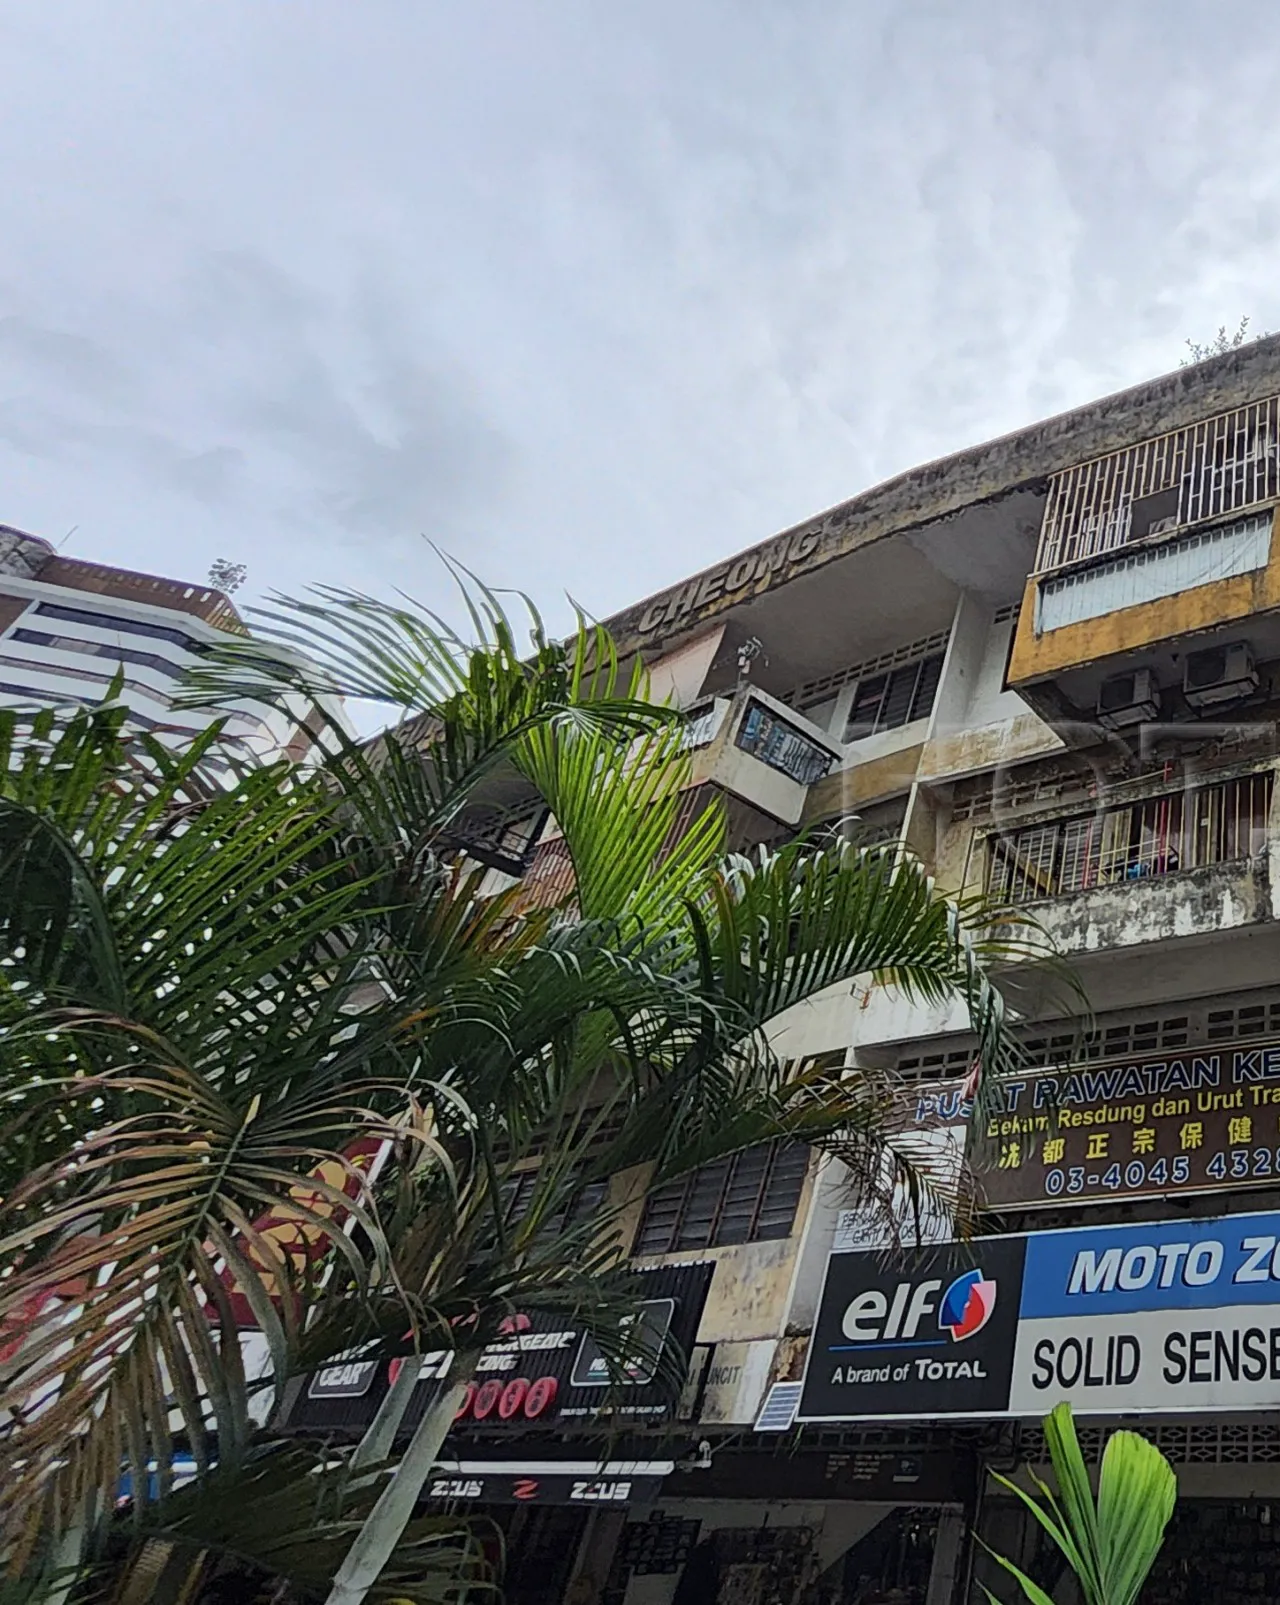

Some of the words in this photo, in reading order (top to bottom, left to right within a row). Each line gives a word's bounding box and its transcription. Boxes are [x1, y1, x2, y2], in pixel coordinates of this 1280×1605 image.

[638, 529, 822, 634] CHEONG
[1033, 1056, 1219, 1108] RAWATAN
[1058, 1103, 1145, 1130] Resdung
[1152, 1097, 1190, 1117] dan
[1197, 1089, 1243, 1112] Urut
[1045, 1155, 1191, 1196] 03-4045
[1066, 1239, 1223, 1295] MOTO
[841, 1279, 942, 1342] elf
[831, 1366, 843, 1385] A
[847, 1363, 889, 1383] brand
[893, 1361, 910, 1381] of
[915, 1358, 988, 1381] TOTAL
[1032, 1334, 1140, 1389] SOLID
